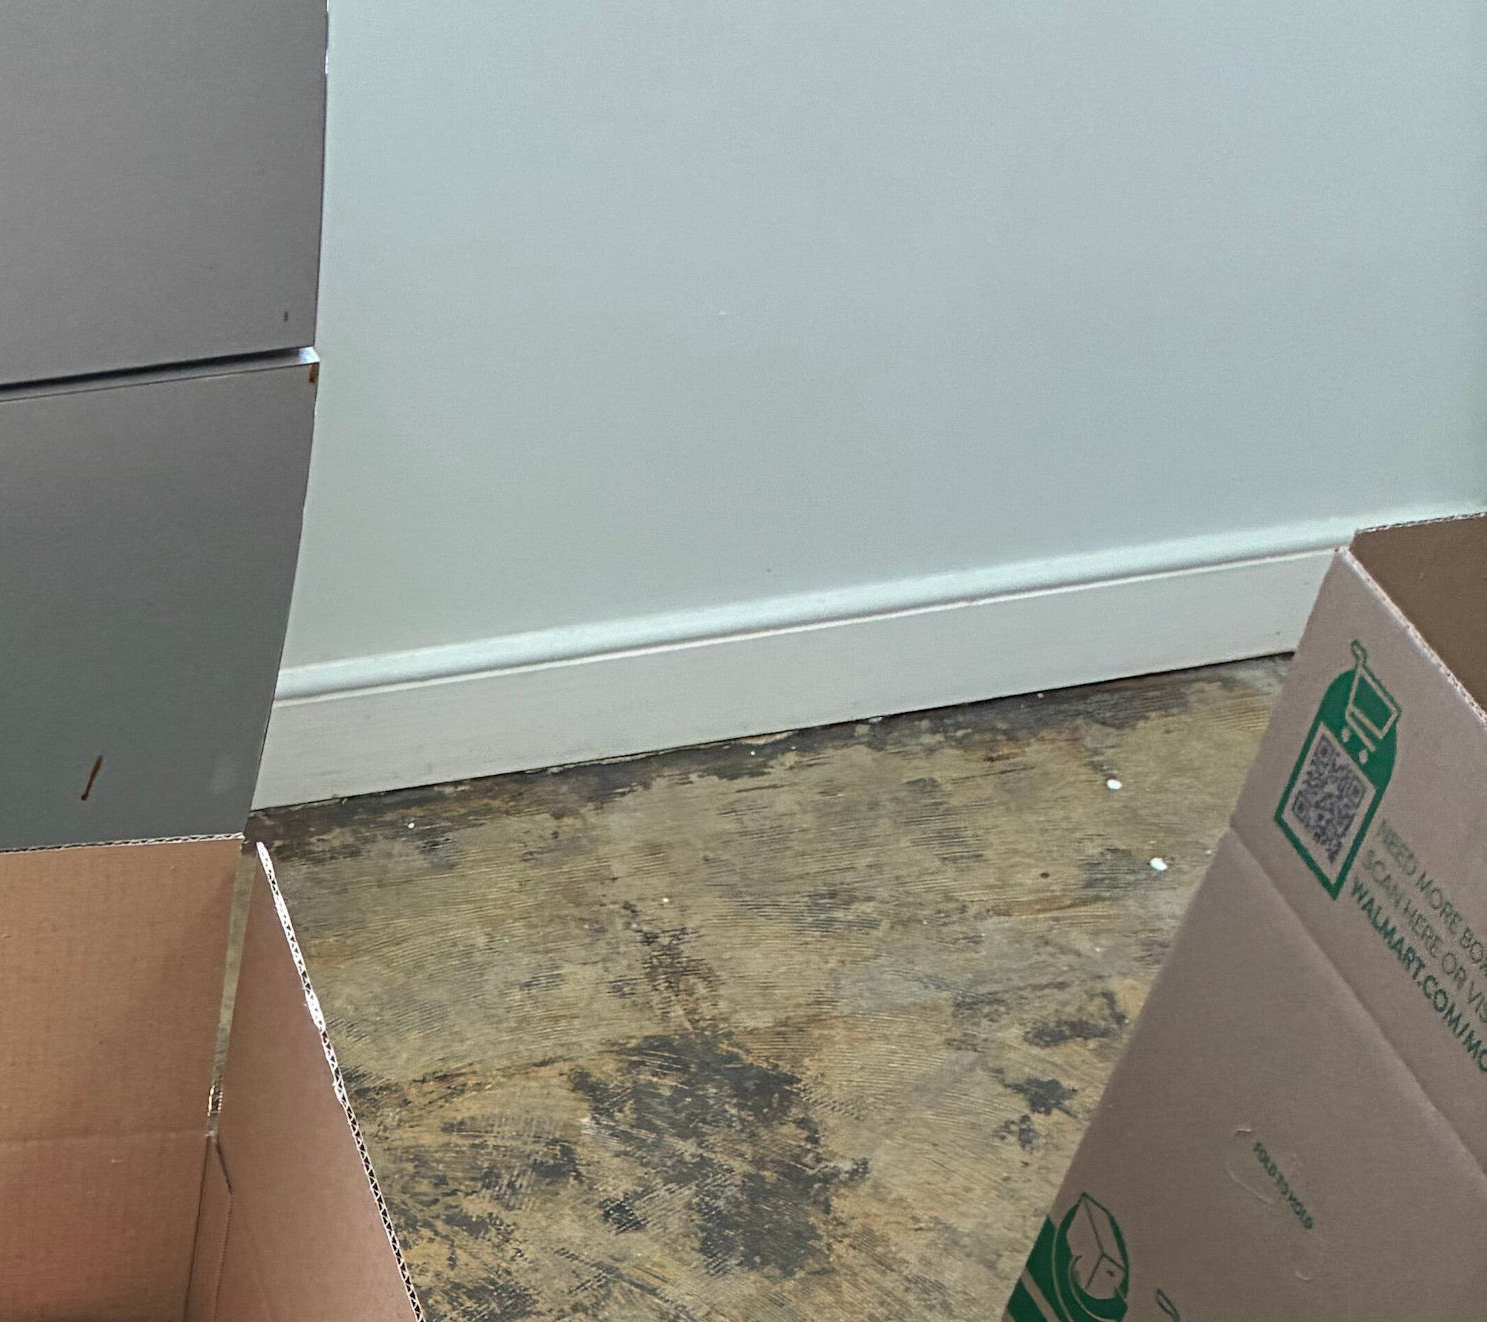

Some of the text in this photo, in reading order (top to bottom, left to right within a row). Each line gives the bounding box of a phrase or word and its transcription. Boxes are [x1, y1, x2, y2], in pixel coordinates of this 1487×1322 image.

[1357, 849, 1408, 908] SCAN
[1397, 901, 1447, 958] HERE
[1436, 951, 1467, 984] OR
[1410, 871, 1467, 936] MORE
